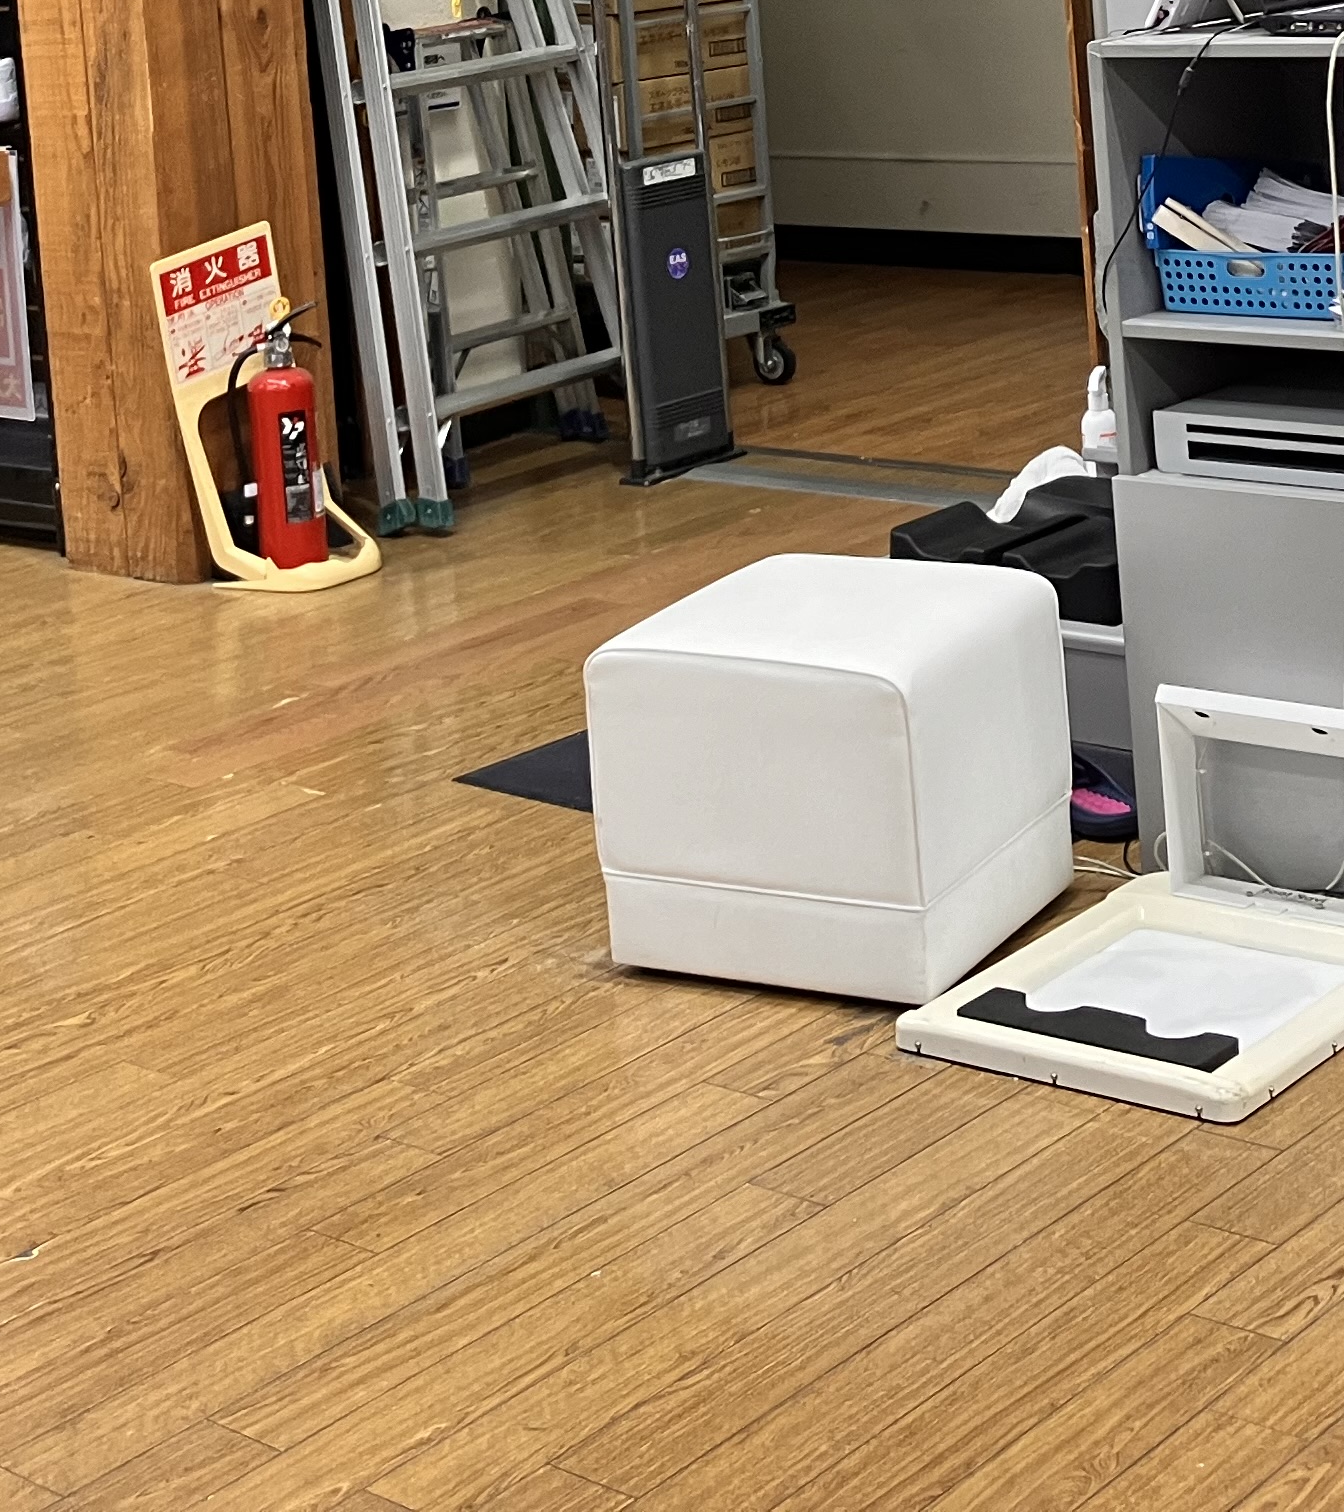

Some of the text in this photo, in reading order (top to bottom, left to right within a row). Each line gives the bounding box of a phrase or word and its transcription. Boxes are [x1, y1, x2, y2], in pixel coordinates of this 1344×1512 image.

[169, 240, 260, 298] 消火器
[174, 293, 196, 311] FIRE
